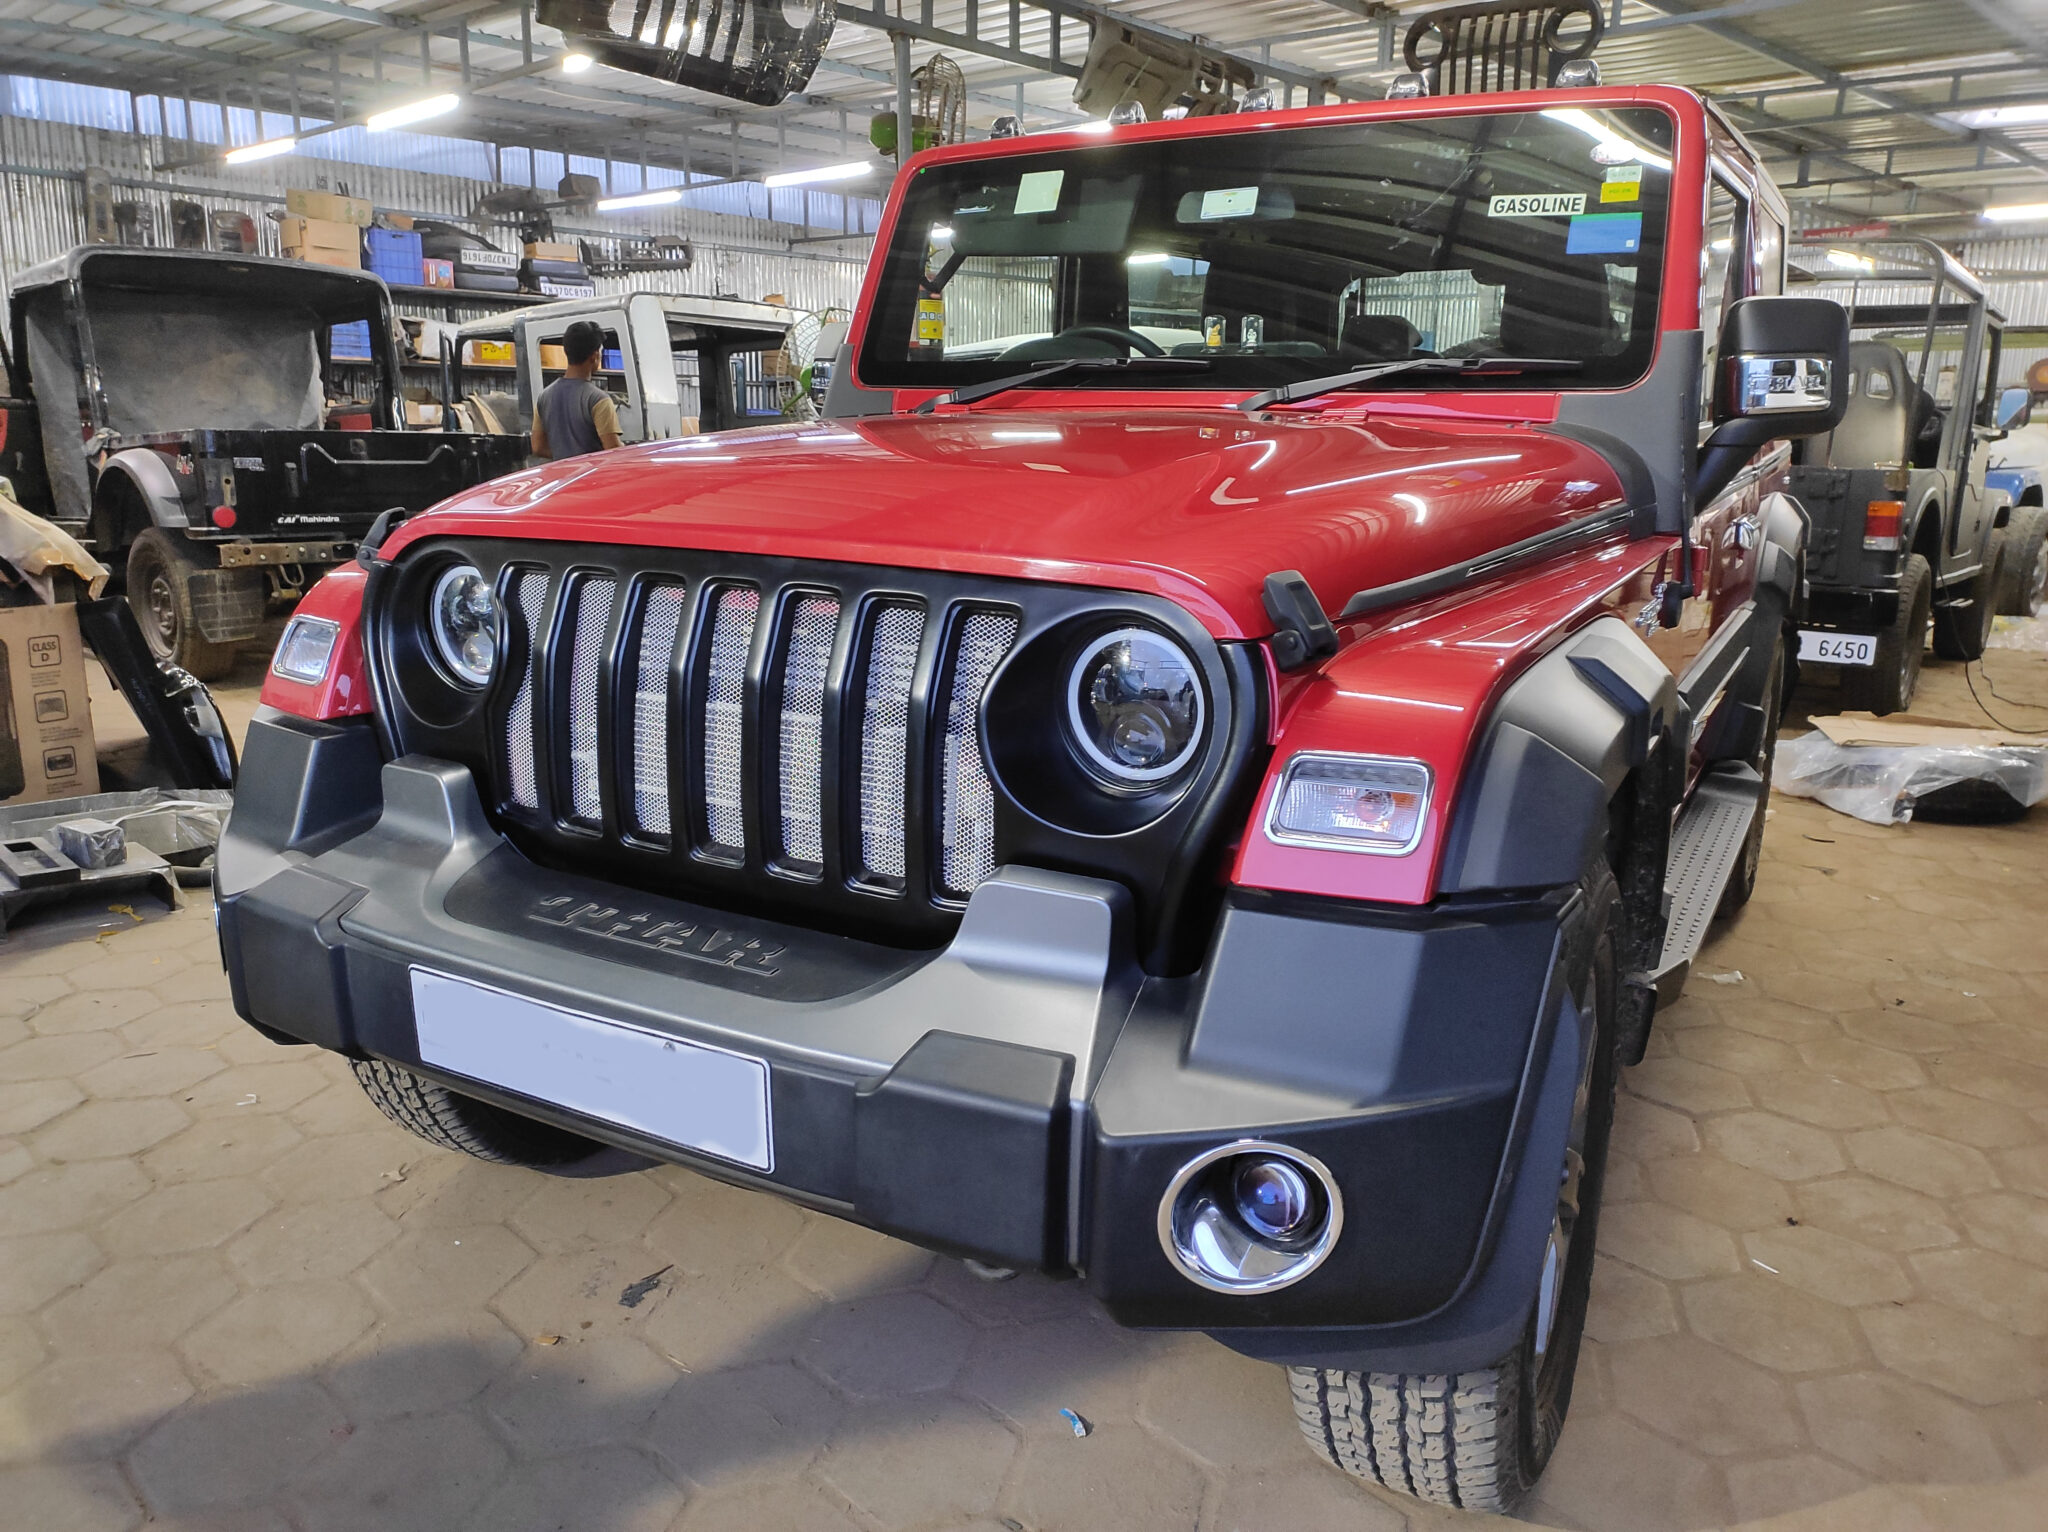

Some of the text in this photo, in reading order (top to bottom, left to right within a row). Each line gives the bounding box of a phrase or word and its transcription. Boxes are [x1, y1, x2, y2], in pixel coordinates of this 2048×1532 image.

[1493, 197, 1583, 214] GASOLINE
[300, 515, 340, 523] Mahindra
[31, 641, 57, 652] CLASS
[1819, 640, 1868, 660] 6450
[41, 652, 50, 662] D
